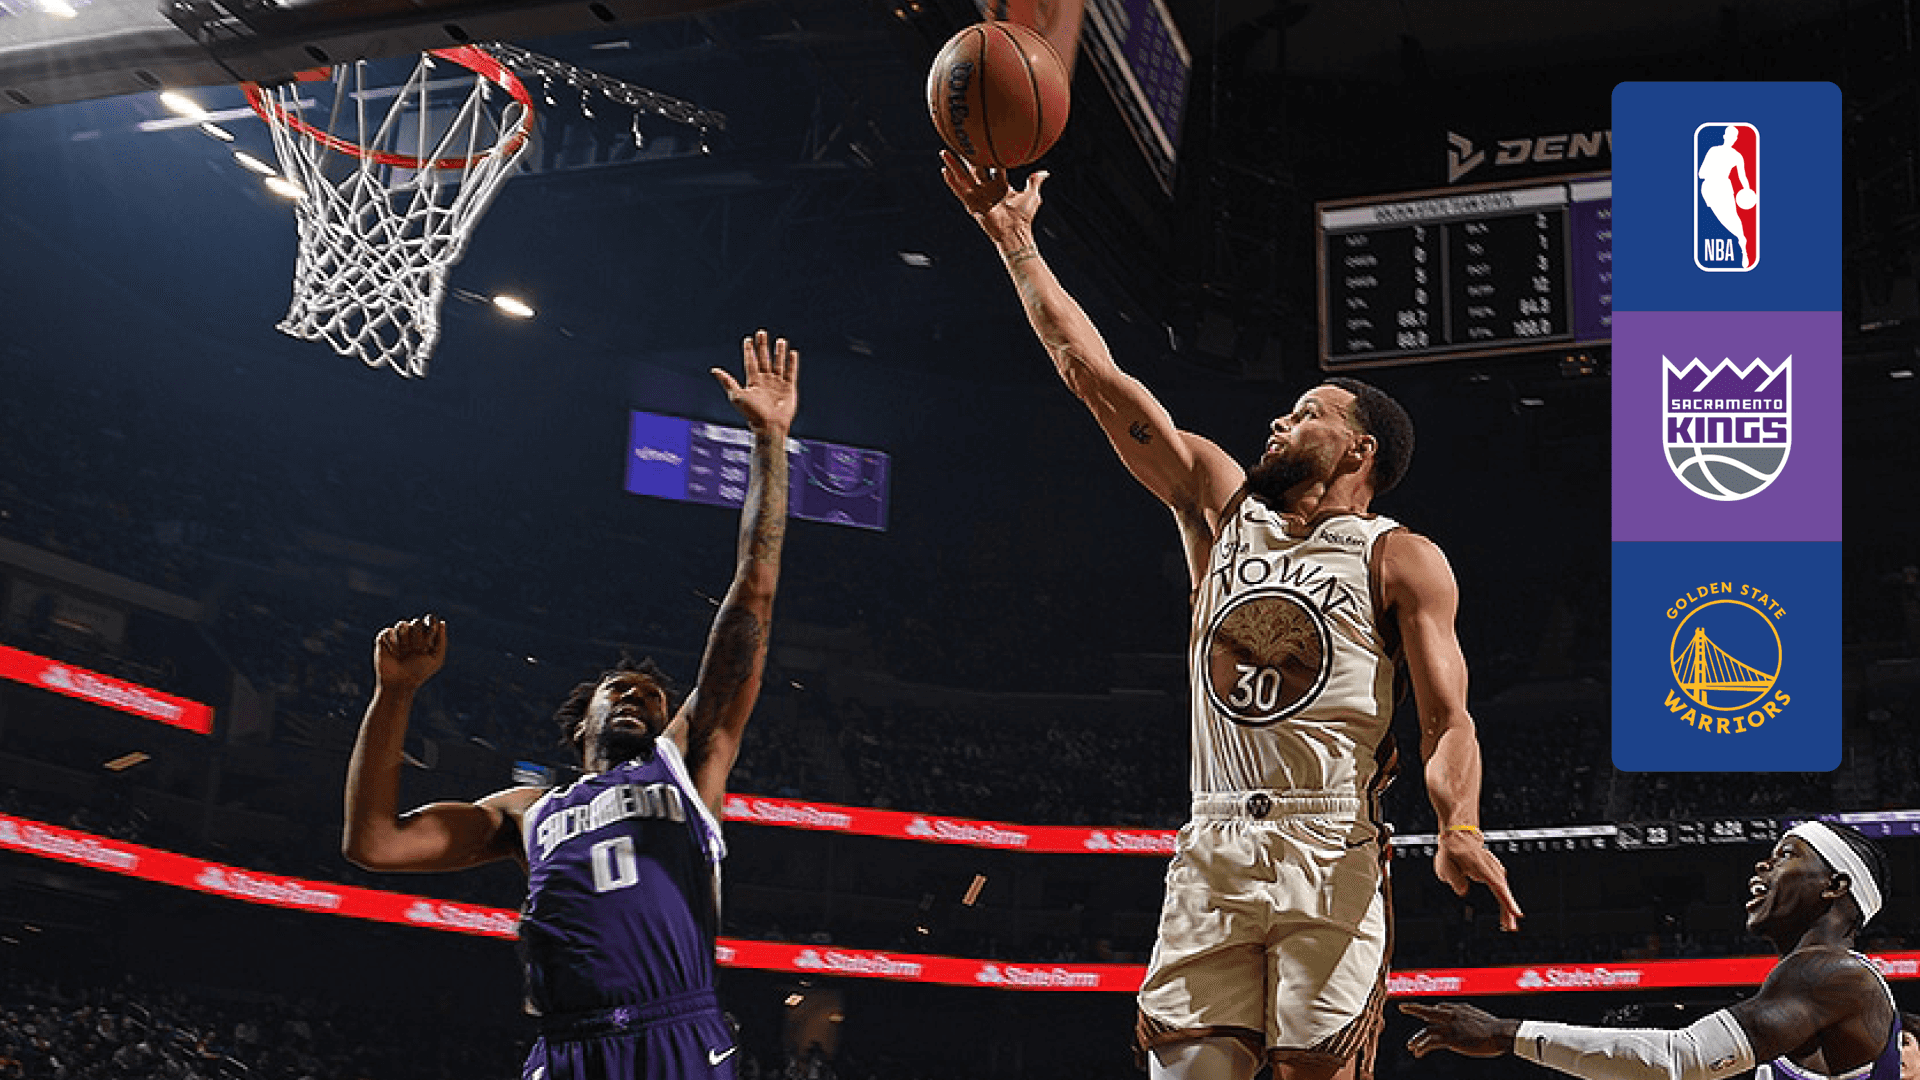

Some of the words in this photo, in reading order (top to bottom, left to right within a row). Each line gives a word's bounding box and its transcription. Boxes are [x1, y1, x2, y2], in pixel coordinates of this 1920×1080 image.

[1212, 554, 1355, 613] TOWN
[1229, 664, 1281, 711] 30
[536, 782, 688, 861] SACRAMENTO
[591, 836, 639, 892] 0
